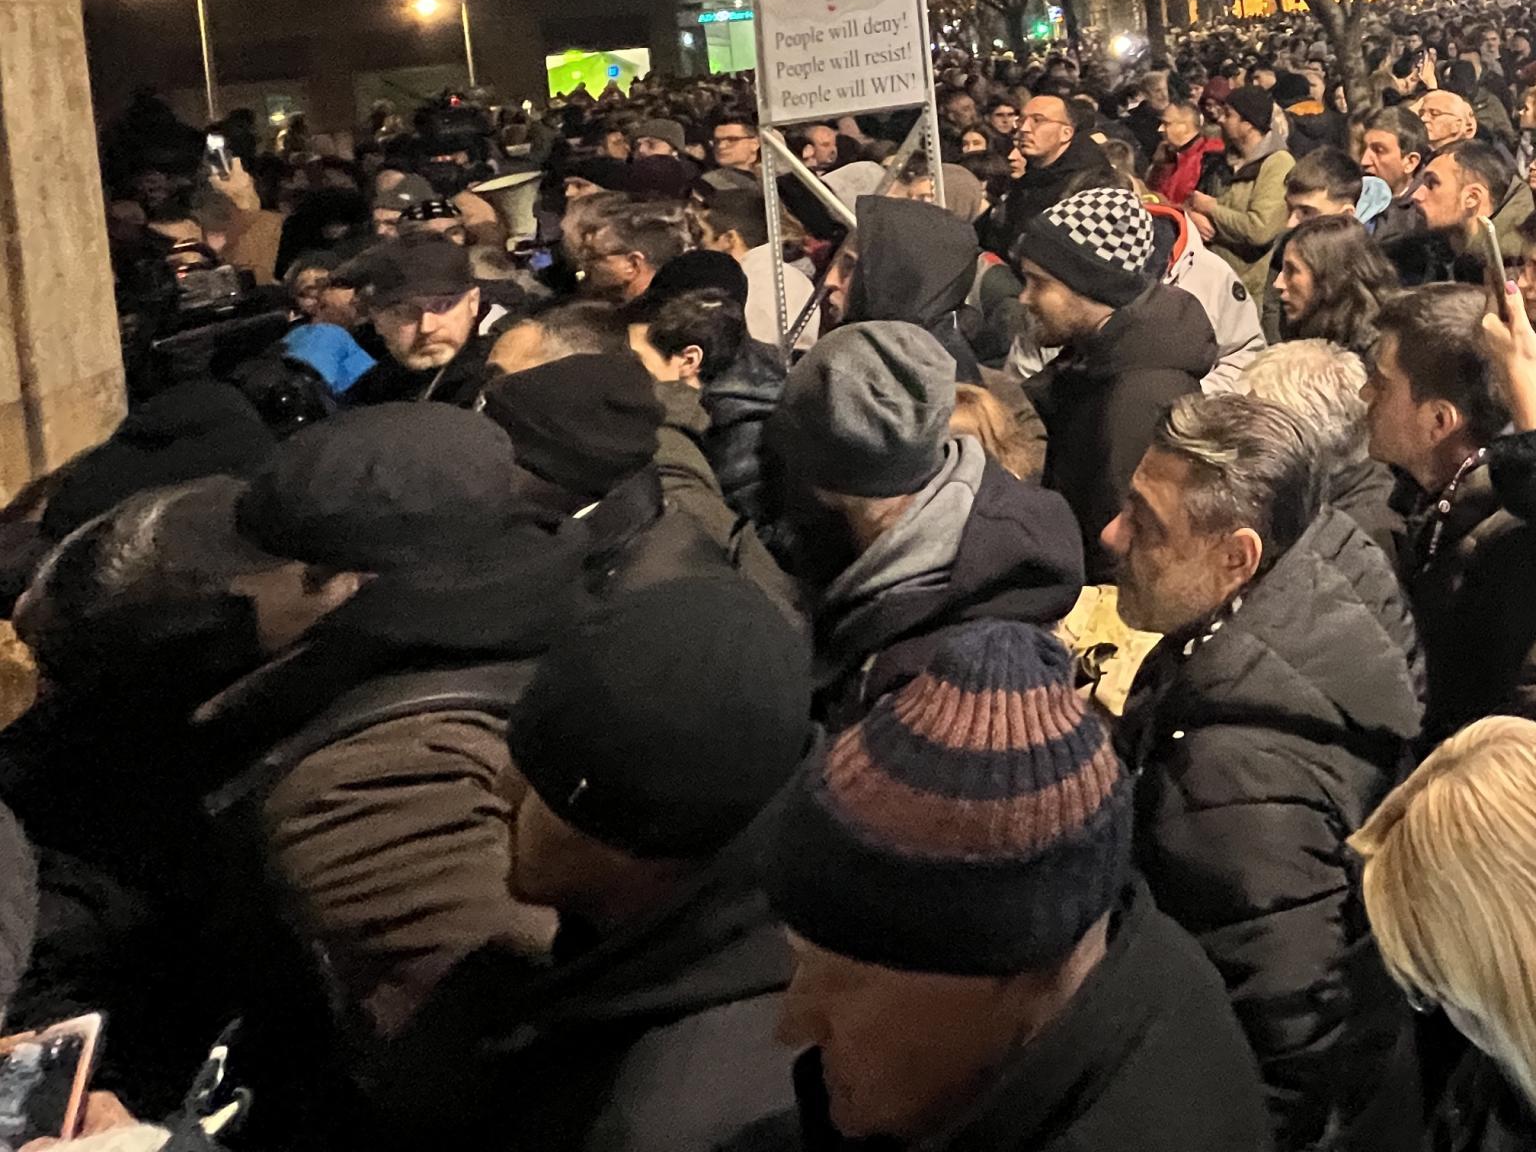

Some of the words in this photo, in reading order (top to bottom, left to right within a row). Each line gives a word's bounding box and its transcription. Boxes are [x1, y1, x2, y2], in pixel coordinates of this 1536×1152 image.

[775, 25, 824, 51] People
[828, 18, 859, 39] will
[863, 11, 909, 36] deny!
[776, 55, 825, 80] People
[829, 49, 861, 70] will
[864, 41, 912, 66] resist!
[782, 84, 832, 109] People
[836, 78, 866, 99] will
[870, 72, 917, 95] WIN!
